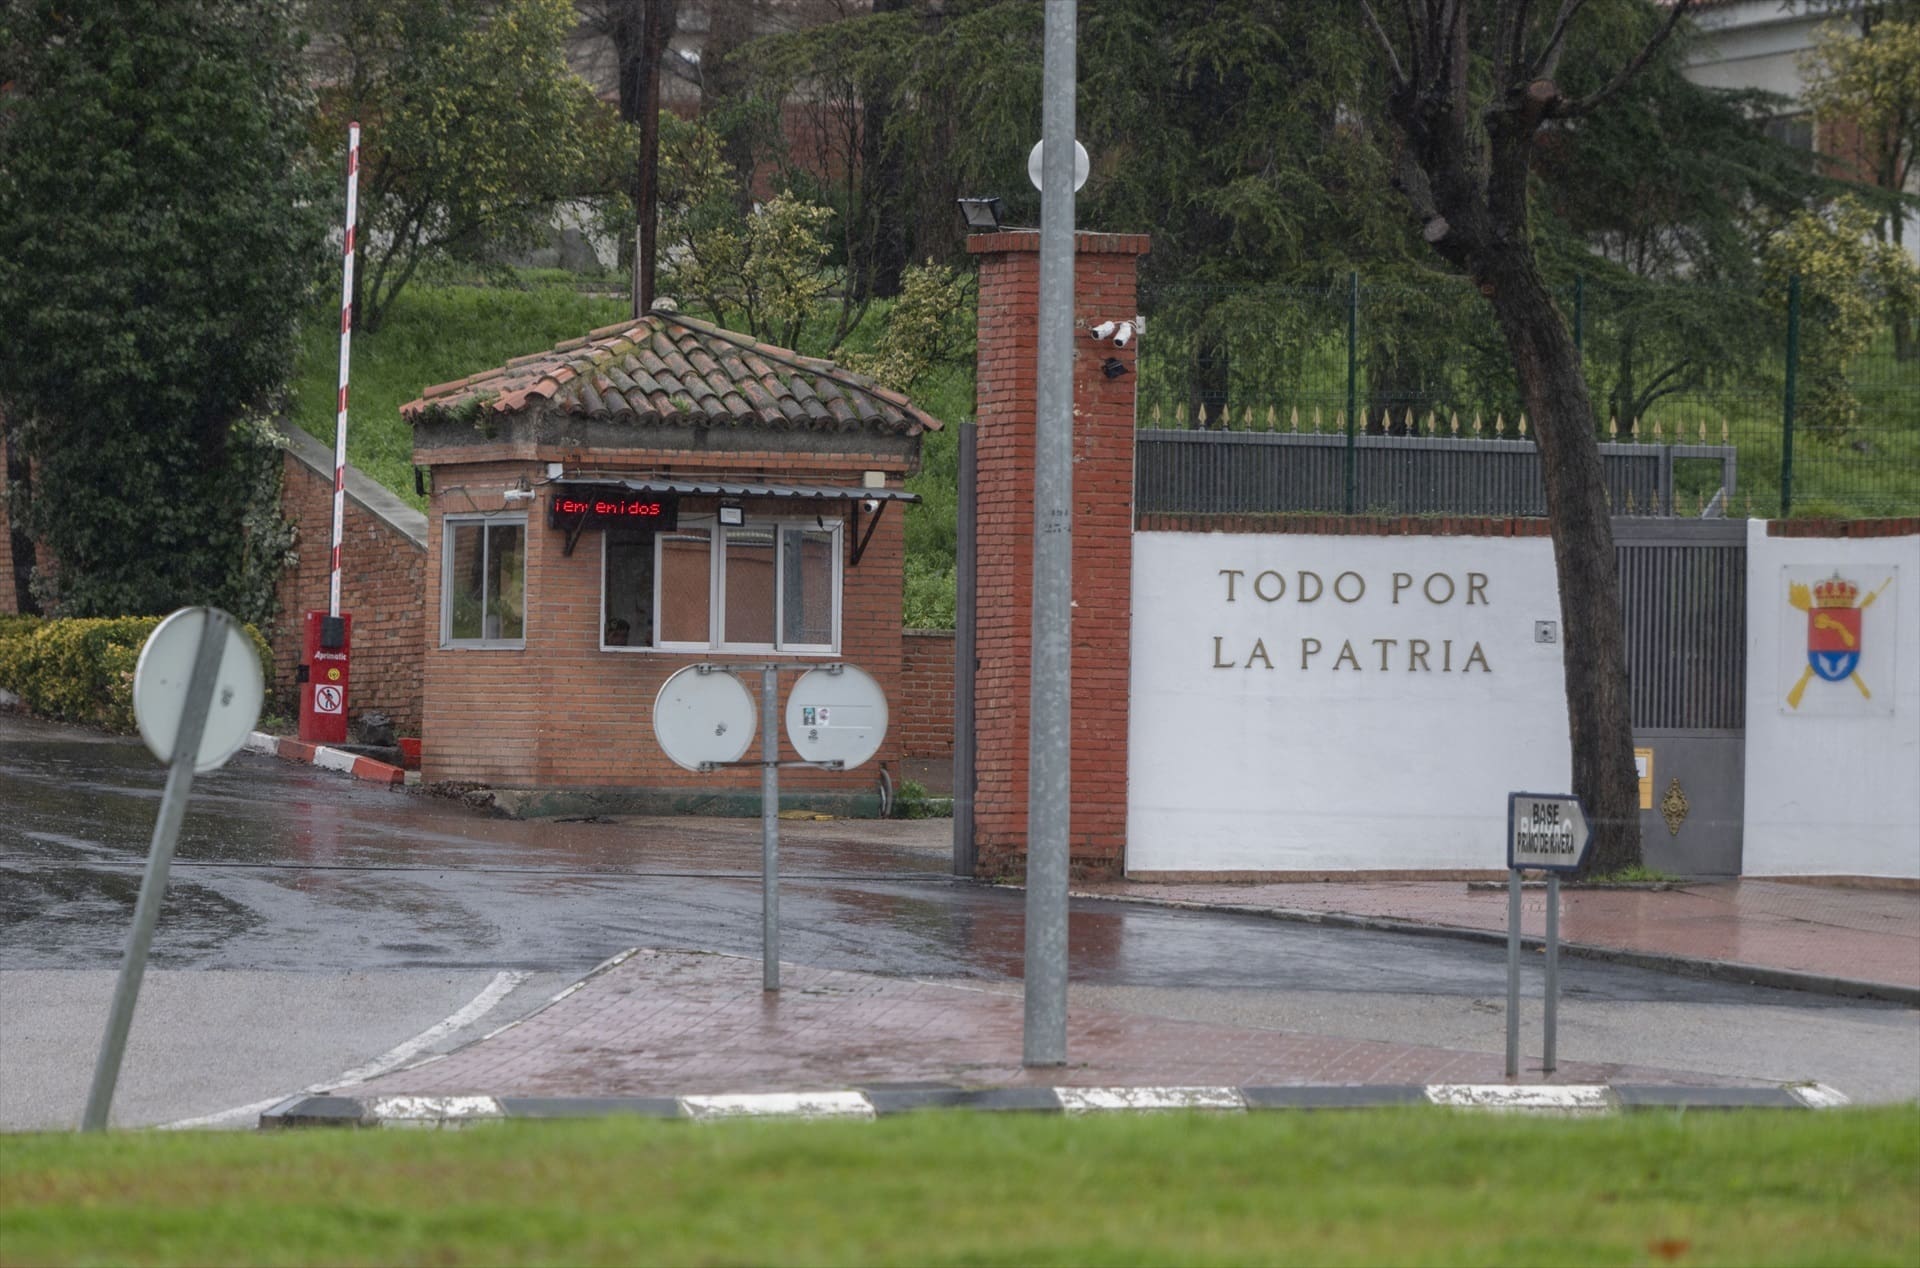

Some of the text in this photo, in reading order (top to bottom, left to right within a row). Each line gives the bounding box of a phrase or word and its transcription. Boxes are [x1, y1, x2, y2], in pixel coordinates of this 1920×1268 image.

[1218, 569, 1490, 605] TODO POR
[314, 650, 348, 661] Aprimatic
[1212, 636, 1492, 673] LA PATRIA
[1532, 803, 1560, 825] BASE
[1517, 832, 1575, 855] PRIMO DE RIVERA
